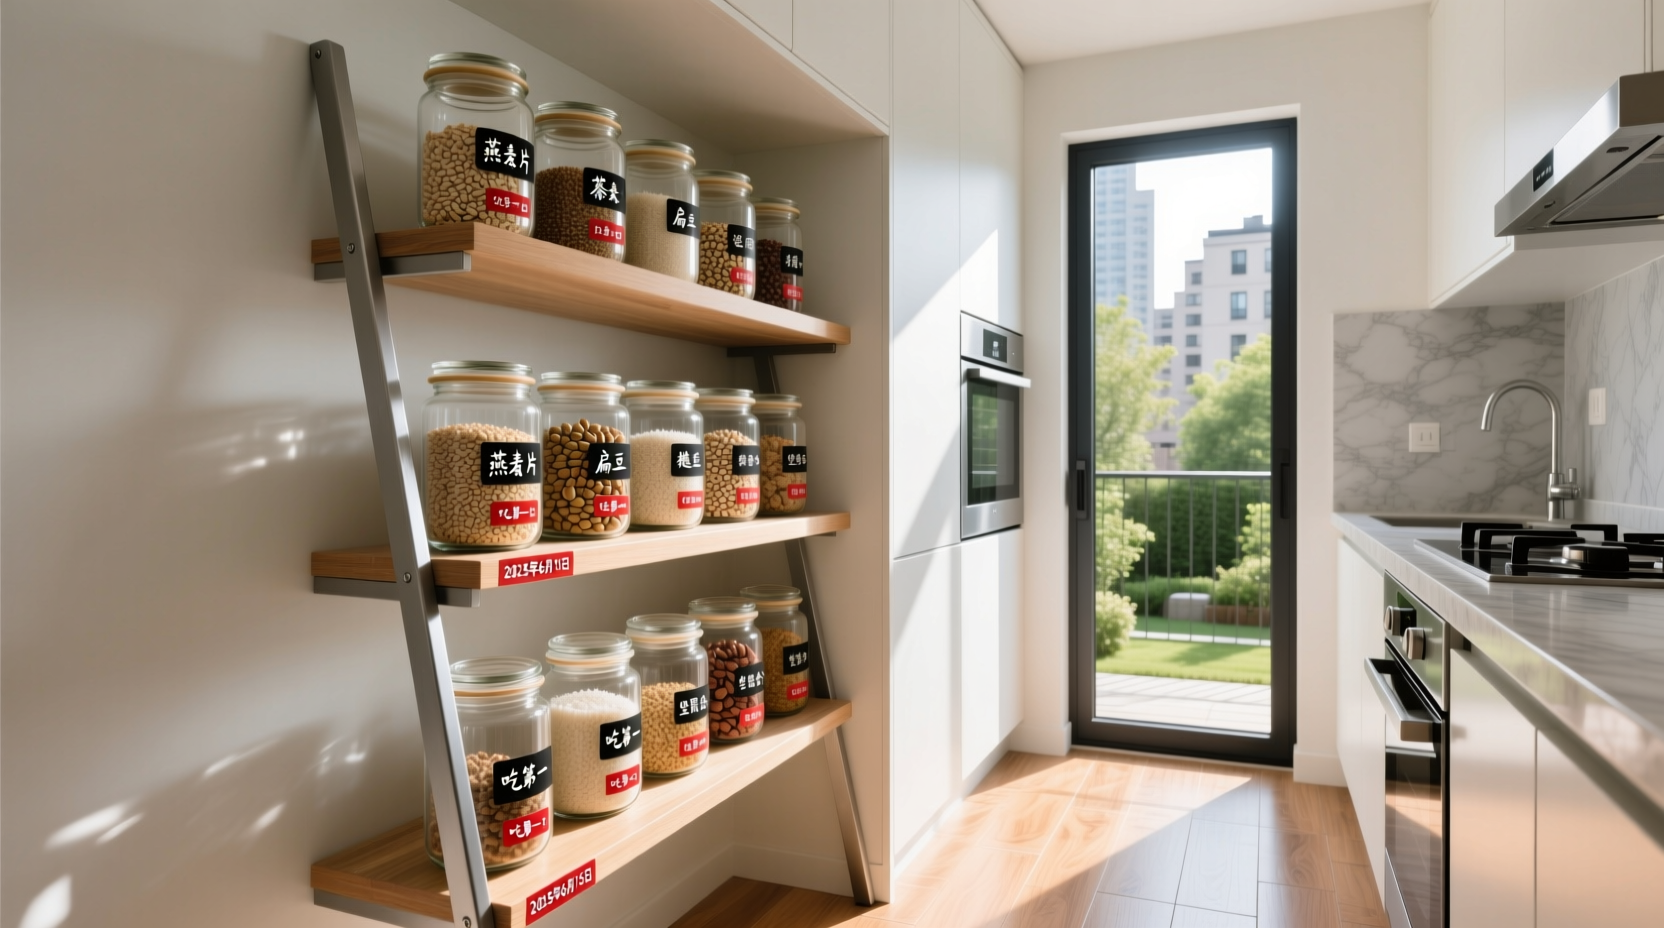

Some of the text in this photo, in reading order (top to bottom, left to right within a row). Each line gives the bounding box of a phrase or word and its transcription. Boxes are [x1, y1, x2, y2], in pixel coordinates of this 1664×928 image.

[488, 449, 537, 478] 燕麦片
[594, 449, 627, 475] 扁豆
[605, 725, 641, 749] 吃第一
[500, 761, 548, 792] 吃第一
